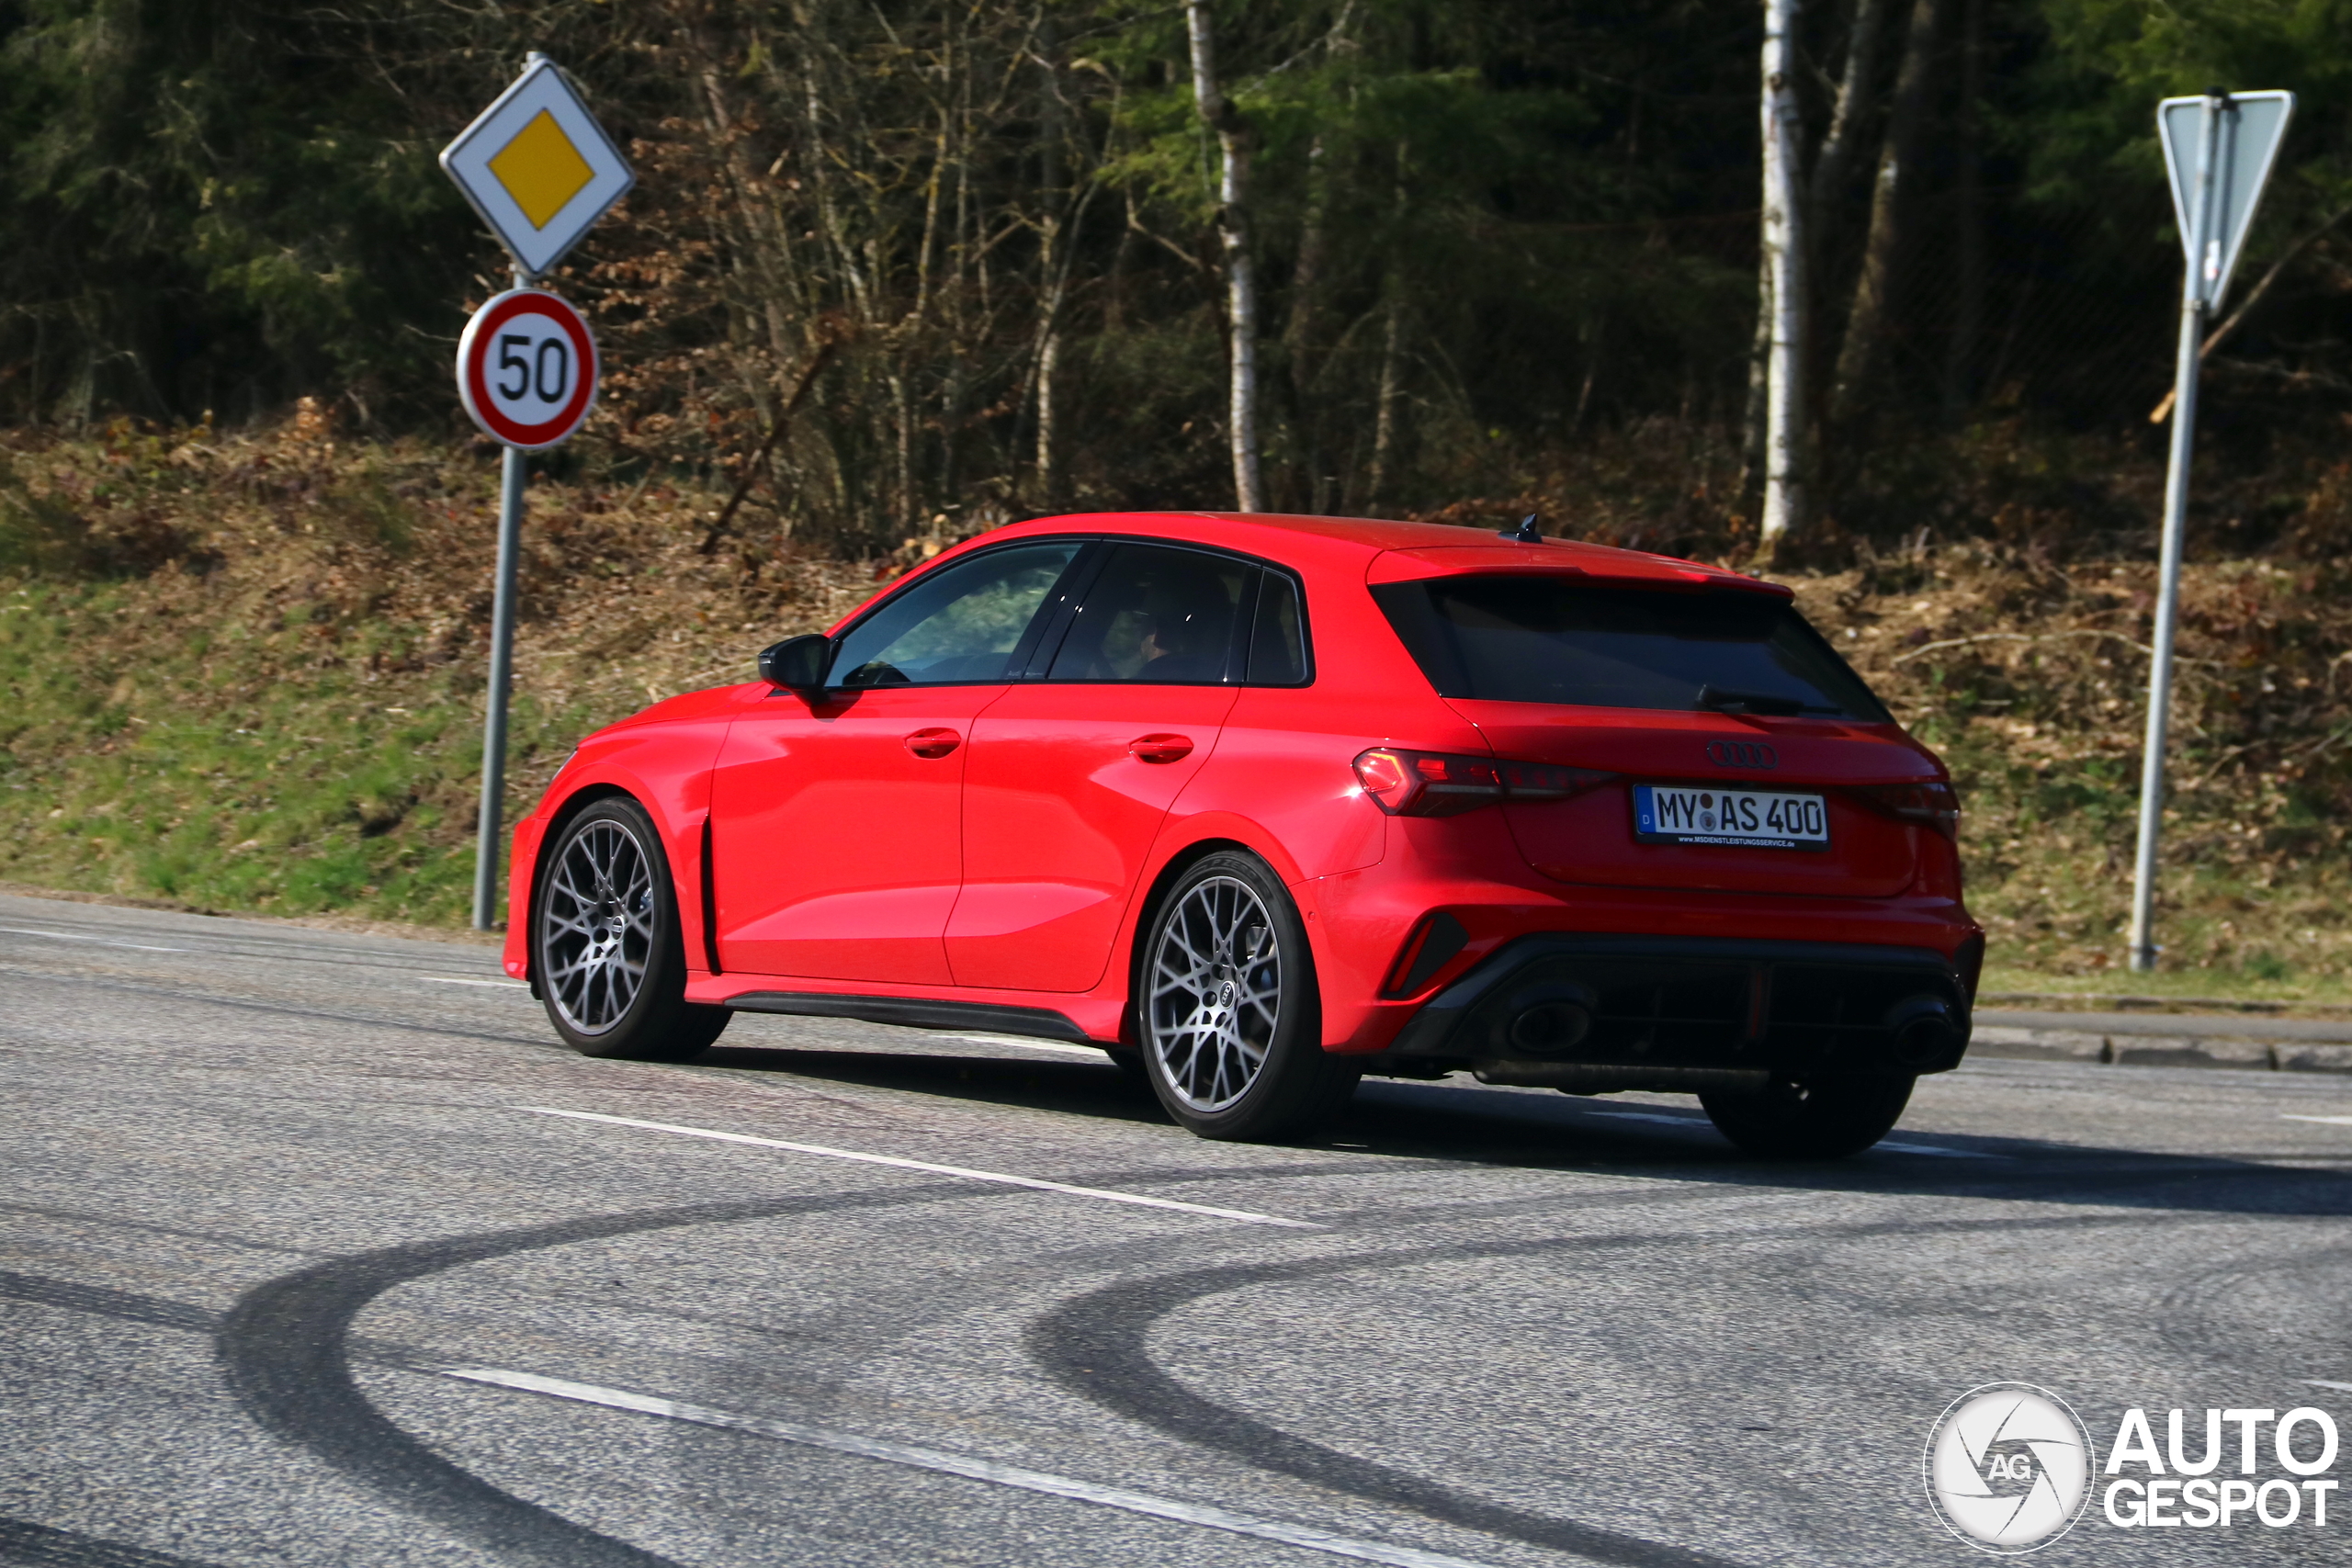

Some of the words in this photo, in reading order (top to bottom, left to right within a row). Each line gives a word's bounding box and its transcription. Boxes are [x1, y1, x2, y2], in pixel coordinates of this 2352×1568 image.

[498, 333, 568, 404] 50
[1642, 814, 1650, 825] D
[1657, 793, 1697, 829] MY
[1721, 795, 1759, 832] AS
[1767, 798, 1823, 836] 400
[1678, 836, 1795, 848] www.MSDIENSTLEISTUNGSSERVICE.de
